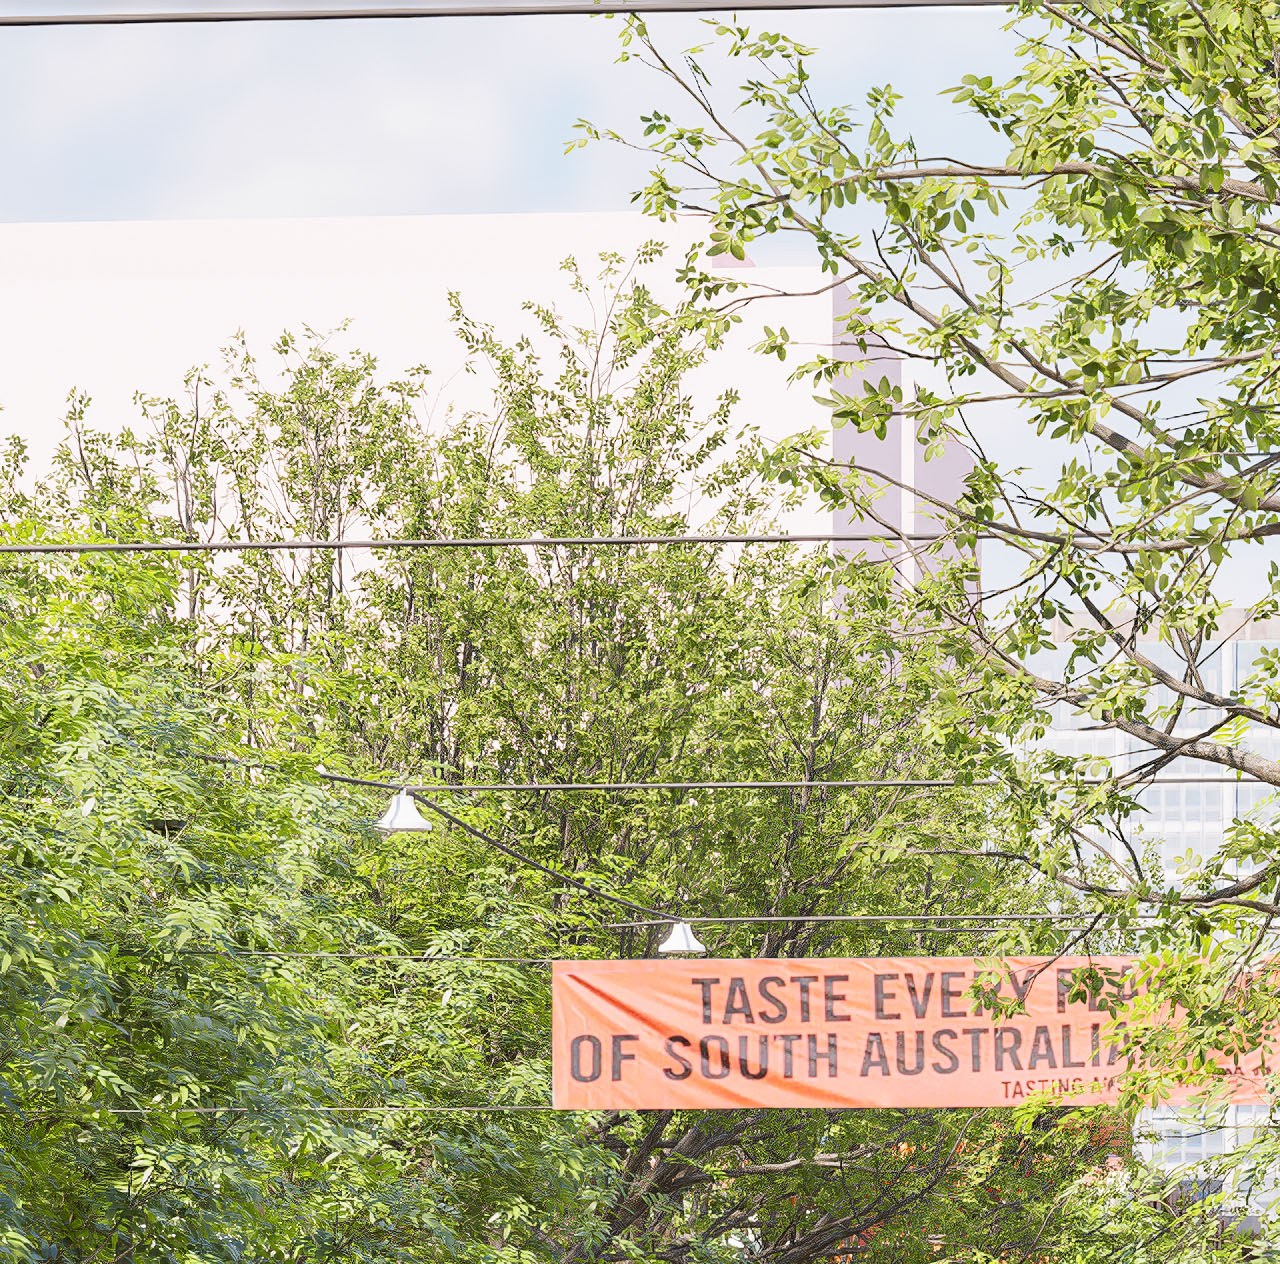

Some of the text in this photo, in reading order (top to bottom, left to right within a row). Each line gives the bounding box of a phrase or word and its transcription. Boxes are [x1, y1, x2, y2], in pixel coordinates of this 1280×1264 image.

[691, 974, 851, 1024] TASTE
[570, 1034, 639, 1083] OF
[663, 1032, 838, 1081] SOUTH
